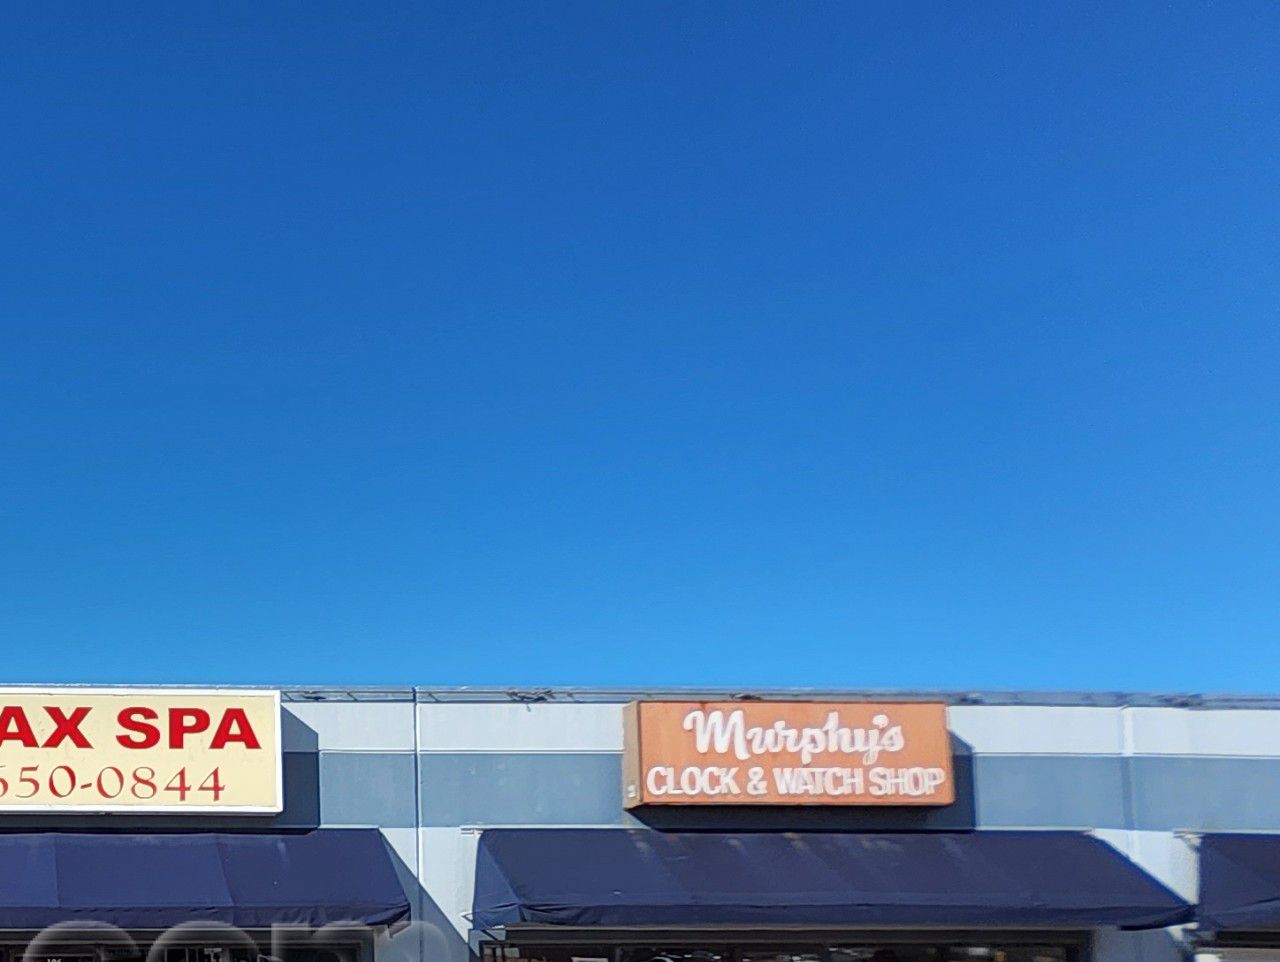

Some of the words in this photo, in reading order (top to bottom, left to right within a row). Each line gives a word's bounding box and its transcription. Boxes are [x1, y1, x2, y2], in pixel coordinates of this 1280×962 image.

[115, 706, 261, 750] SPA
[683, 709, 905, 766] Murphy's
[646, 766, 741, 796] CLOCK
[747, 766, 768, 795] &
[772, 767, 864, 795] WATCH
[868, 767, 947, 796] SHOP
